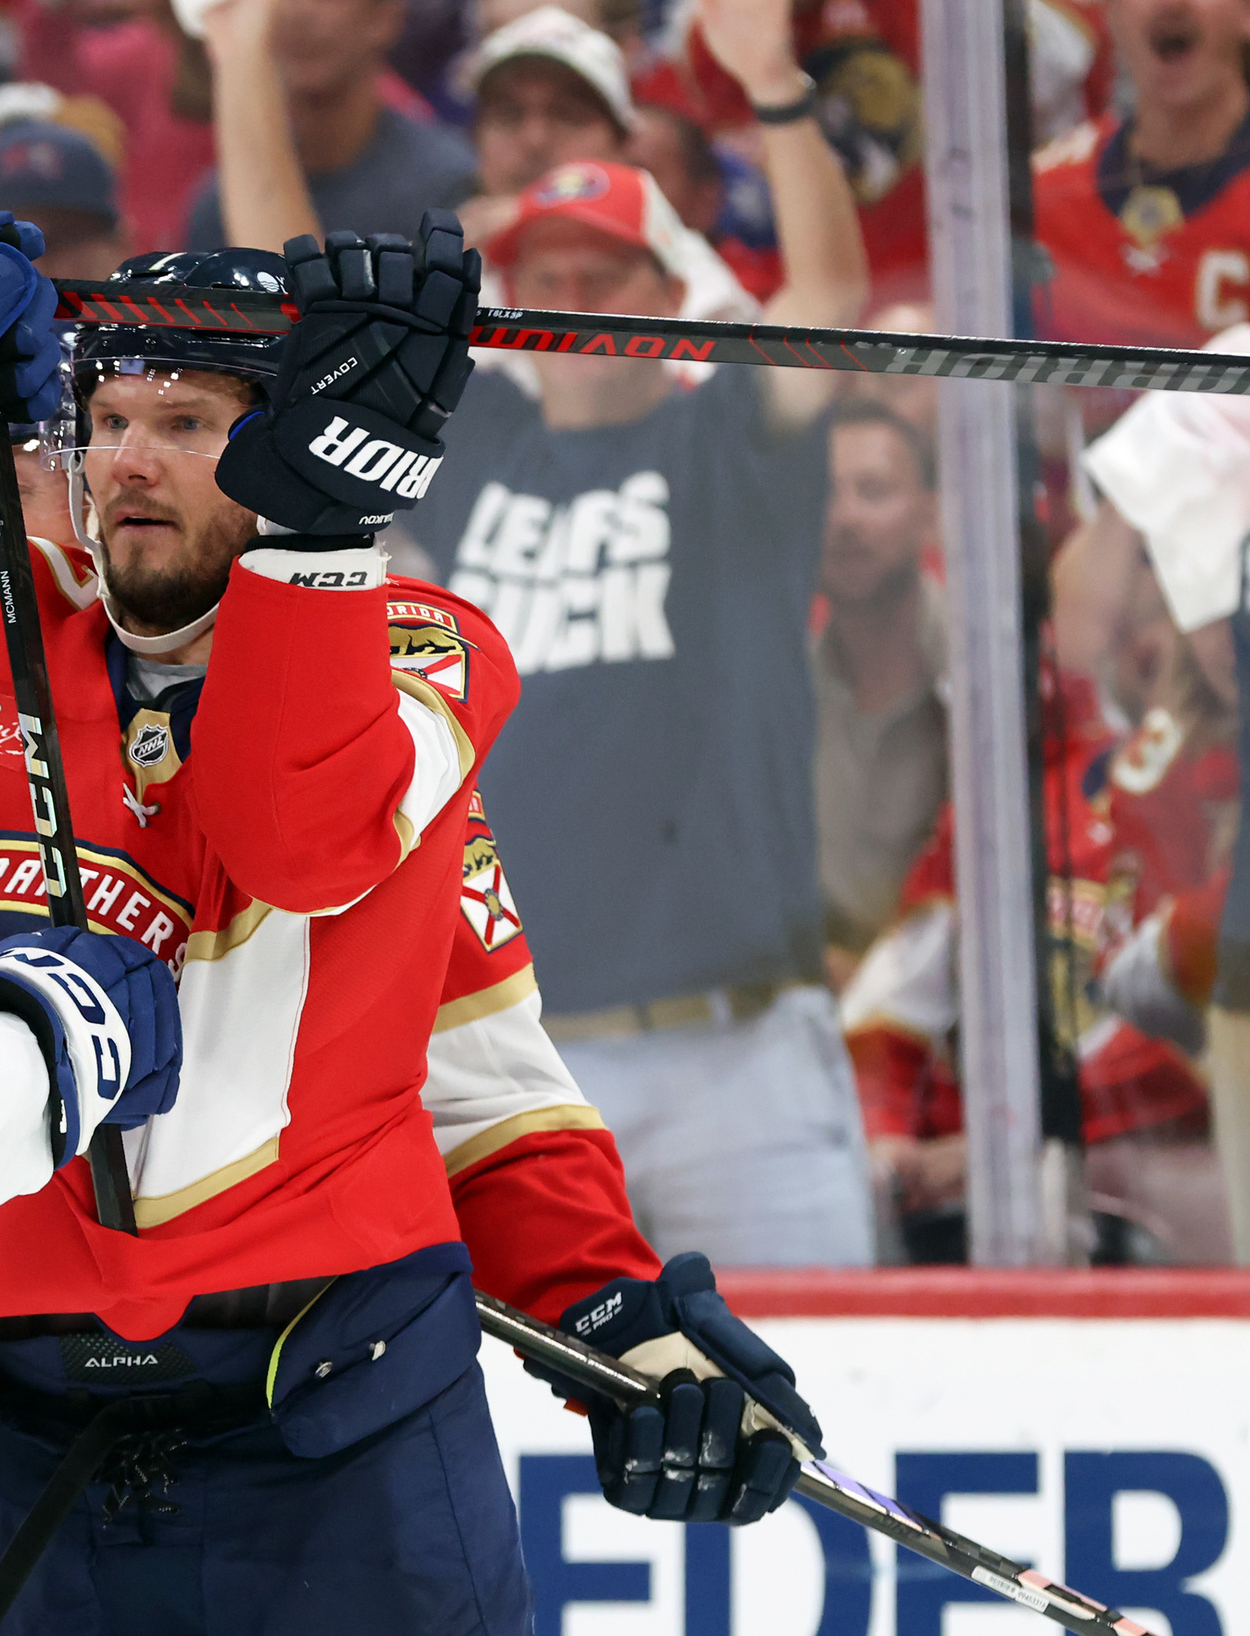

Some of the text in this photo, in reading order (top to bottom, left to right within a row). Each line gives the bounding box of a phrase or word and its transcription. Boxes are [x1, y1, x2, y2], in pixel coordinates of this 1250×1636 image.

[467, 325, 717, 362] NOVIUM
[310, 356, 359, 395] COVERT
[883, 346, 1250, 394] ARRIOR
[454, 469, 671, 578] LEAFS
[0, 570, 17, 624] MCMANN
[289, 570, 368, 588] CCM
[137, 735, 164, 756] NHL
[18, 712, 67, 898] CCM
[575, 1291, 623, 1332] CCM
[592, 1311, 613, 1330] PRO
[84, 1354, 159, 1368] ALPHA
